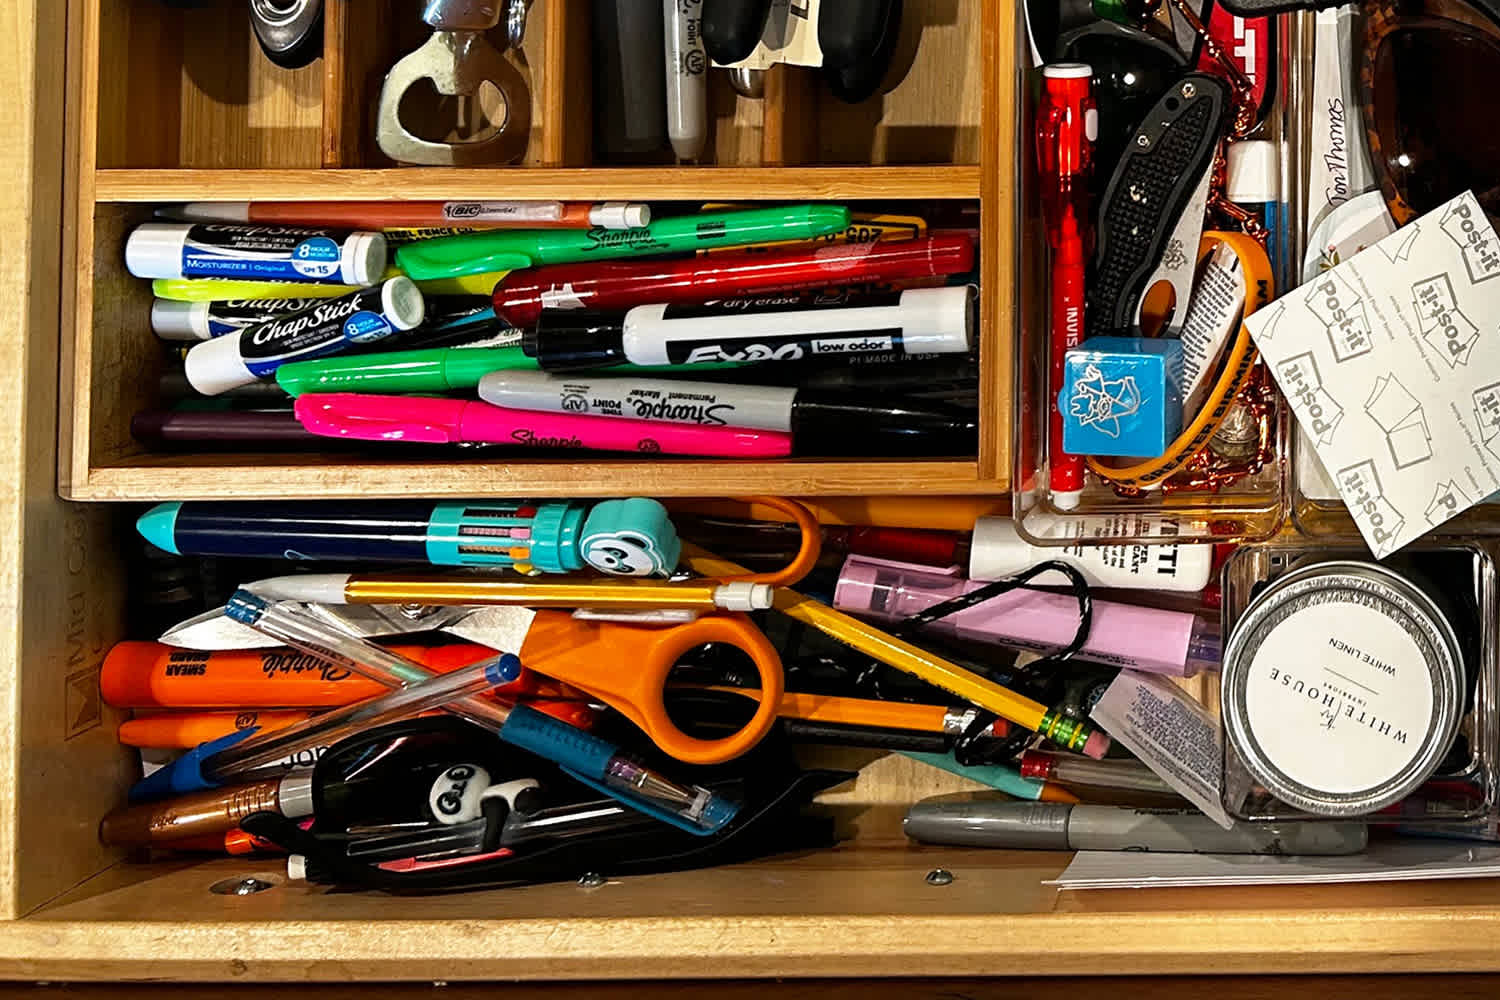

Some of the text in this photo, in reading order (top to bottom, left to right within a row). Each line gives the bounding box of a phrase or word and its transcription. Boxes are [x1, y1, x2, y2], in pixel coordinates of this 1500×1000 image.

[1324, 97, 1347, 171] Thomas
[453, 204, 480, 216] BIC
[582, 228, 656, 251] Sharpie
[299, 244, 309, 258] 8
[318, 265, 328, 274] 15
[723, 296, 800, 310] dry erase
[253, 293, 363, 345] ChapStick
[1317, 279, 1365, 351] Post-it
[1417, 284, 1468, 357] Post-it
[347, 323, 359, 335] 8
[817, 341, 845, 353] low
[848, 338, 885, 351] odor
[865, 354, 895, 363] MADE
[592, 399, 621, 409] POINT
[629, 390, 716, 404] Permanent Marker
[1283, 362, 1331, 436] Post-it
[631, 398, 735, 425] Sharpie
[511, 429, 582, 448] Sharpie
[1342, 472, 1392, 545] Post-it
[263, 650, 351, 681] Sharpie
[1328, 637, 1396, 677] WHITE LINEN
[166, 664, 207, 676] SMEAR
[1269, 668, 1408, 744] WHITE HOUSE
